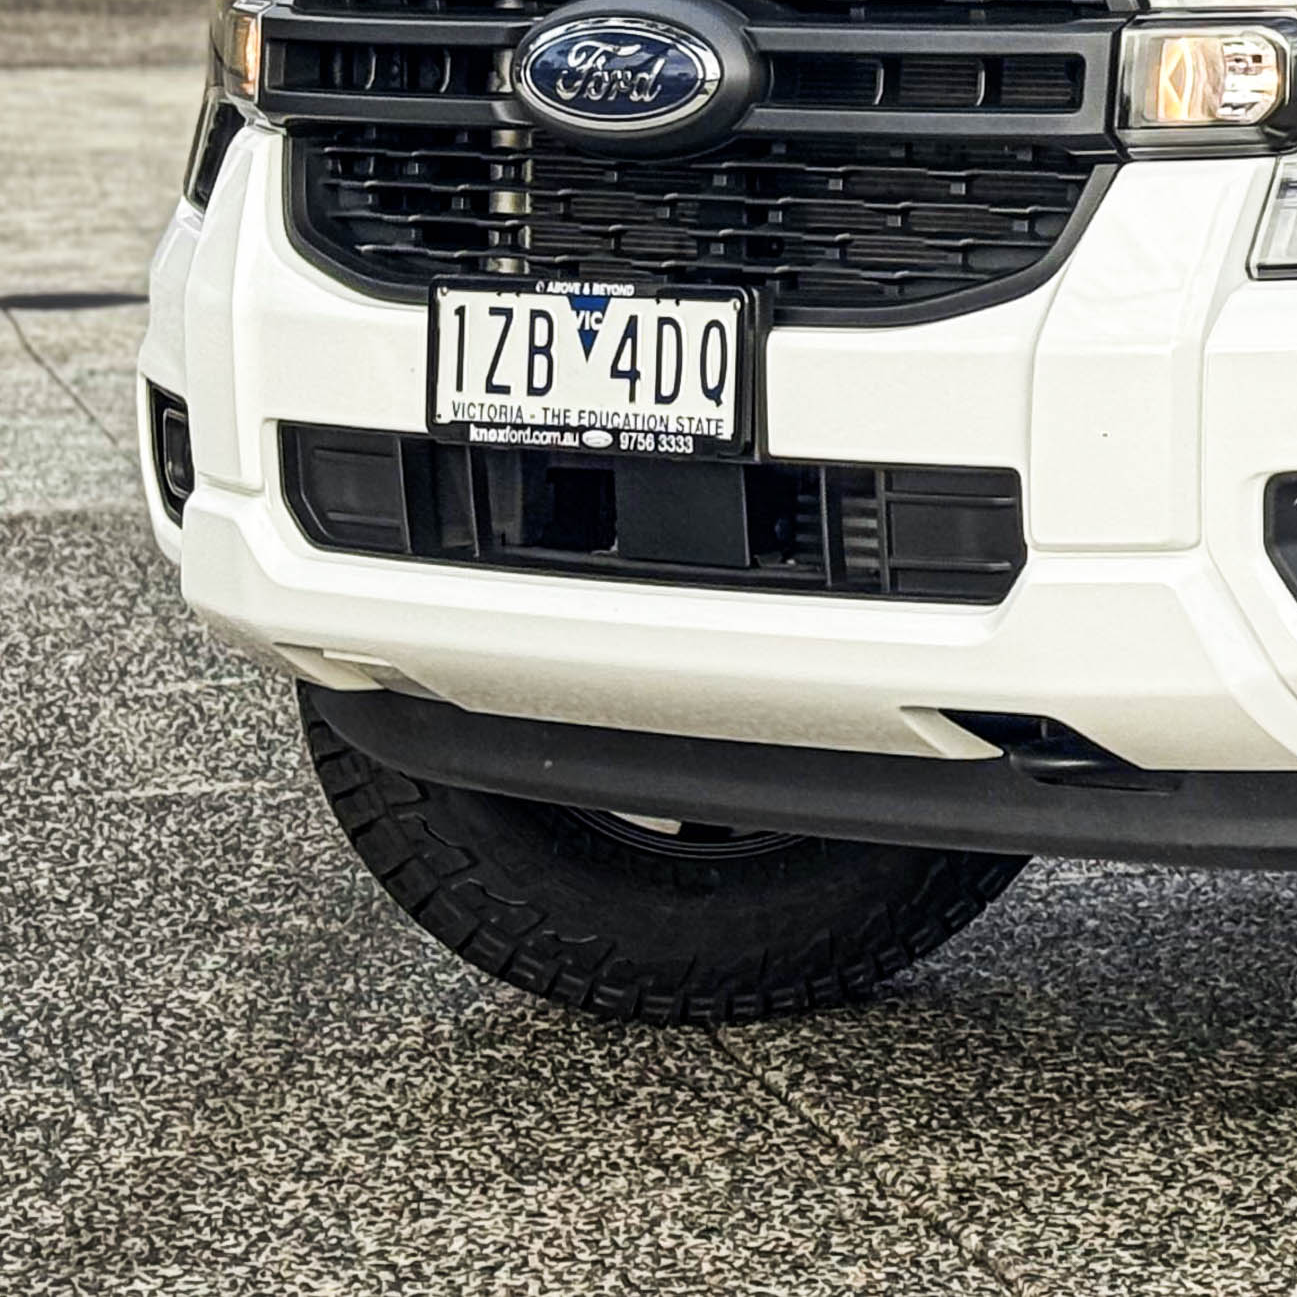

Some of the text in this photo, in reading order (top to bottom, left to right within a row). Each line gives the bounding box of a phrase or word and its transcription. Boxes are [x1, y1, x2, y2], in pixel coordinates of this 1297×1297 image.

[555, 40, 666, 102] Ford
[546, 281, 581, 296] ABOVE
[592, 283, 635, 297] BEYOND
[571, 310, 604, 331] VIC
[609, 314, 728, 407] 4DQ
[451, 400, 524, 423] VICTORIA
[541, 406, 572, 427] THE
[578, 409, 670, 433] EDUCATION
[675, 415, 724, 437] STATE
[469, 423, 580, 447] knoxford.com.au
